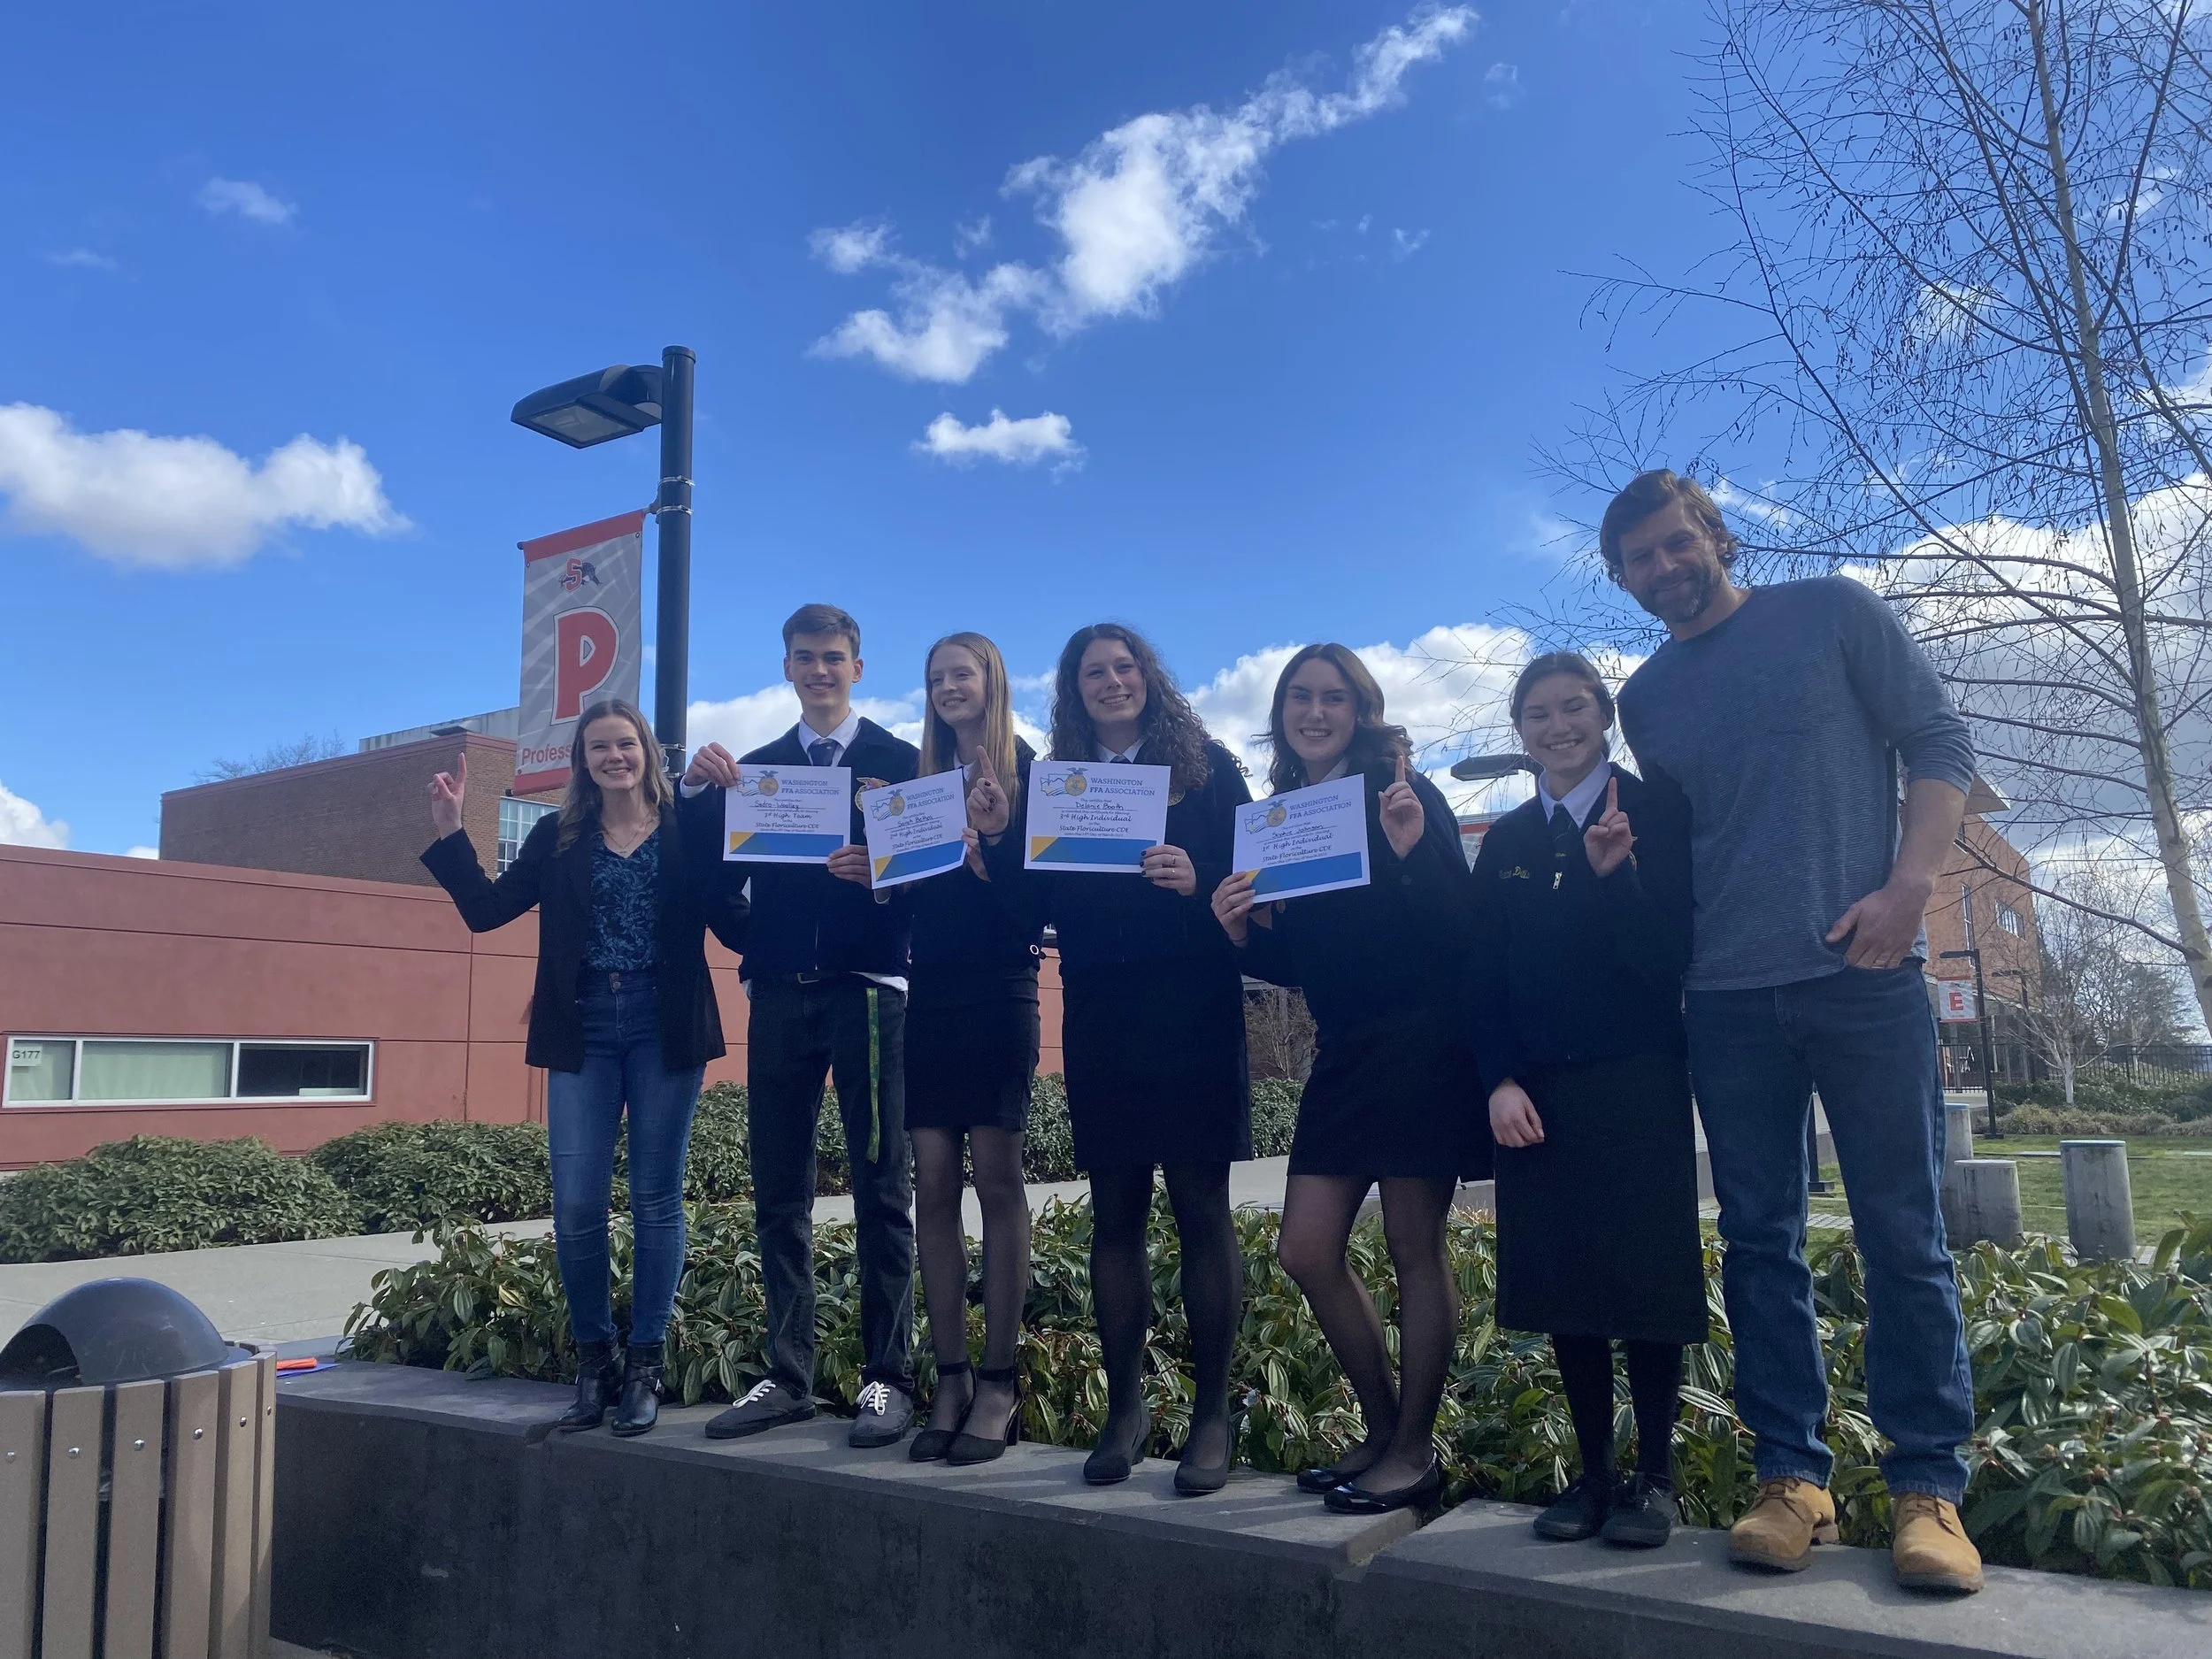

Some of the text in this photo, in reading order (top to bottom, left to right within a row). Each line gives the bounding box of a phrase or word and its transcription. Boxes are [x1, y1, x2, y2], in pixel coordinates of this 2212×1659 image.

[550, 606, 619, 726] P
[522, 744, 572, 765] Profess
[1090, 778, 1143, 787] WASHINGTON
[907, 787, 944, 800] WASHINGTON
[1104, 787, 1156, 796] ASSOCIATION
[918, 793, 955, 807] ASSOCIATION
[1289, 795, 1339, 810] WASHINGTON
[1303, 801, 1352, 817] ASSOCIATION
[1071, 813, 1089, 823] High
[1273, 841, 1291, 851] High
[1292, 832, 1333, 846] Individual
[1262, 854, 1279, 864] State
[1279, 847, 1318, 860] Floriculture
[1948, 992, 1964, 1011] E
[12, 1050, 41, 1059] G177
